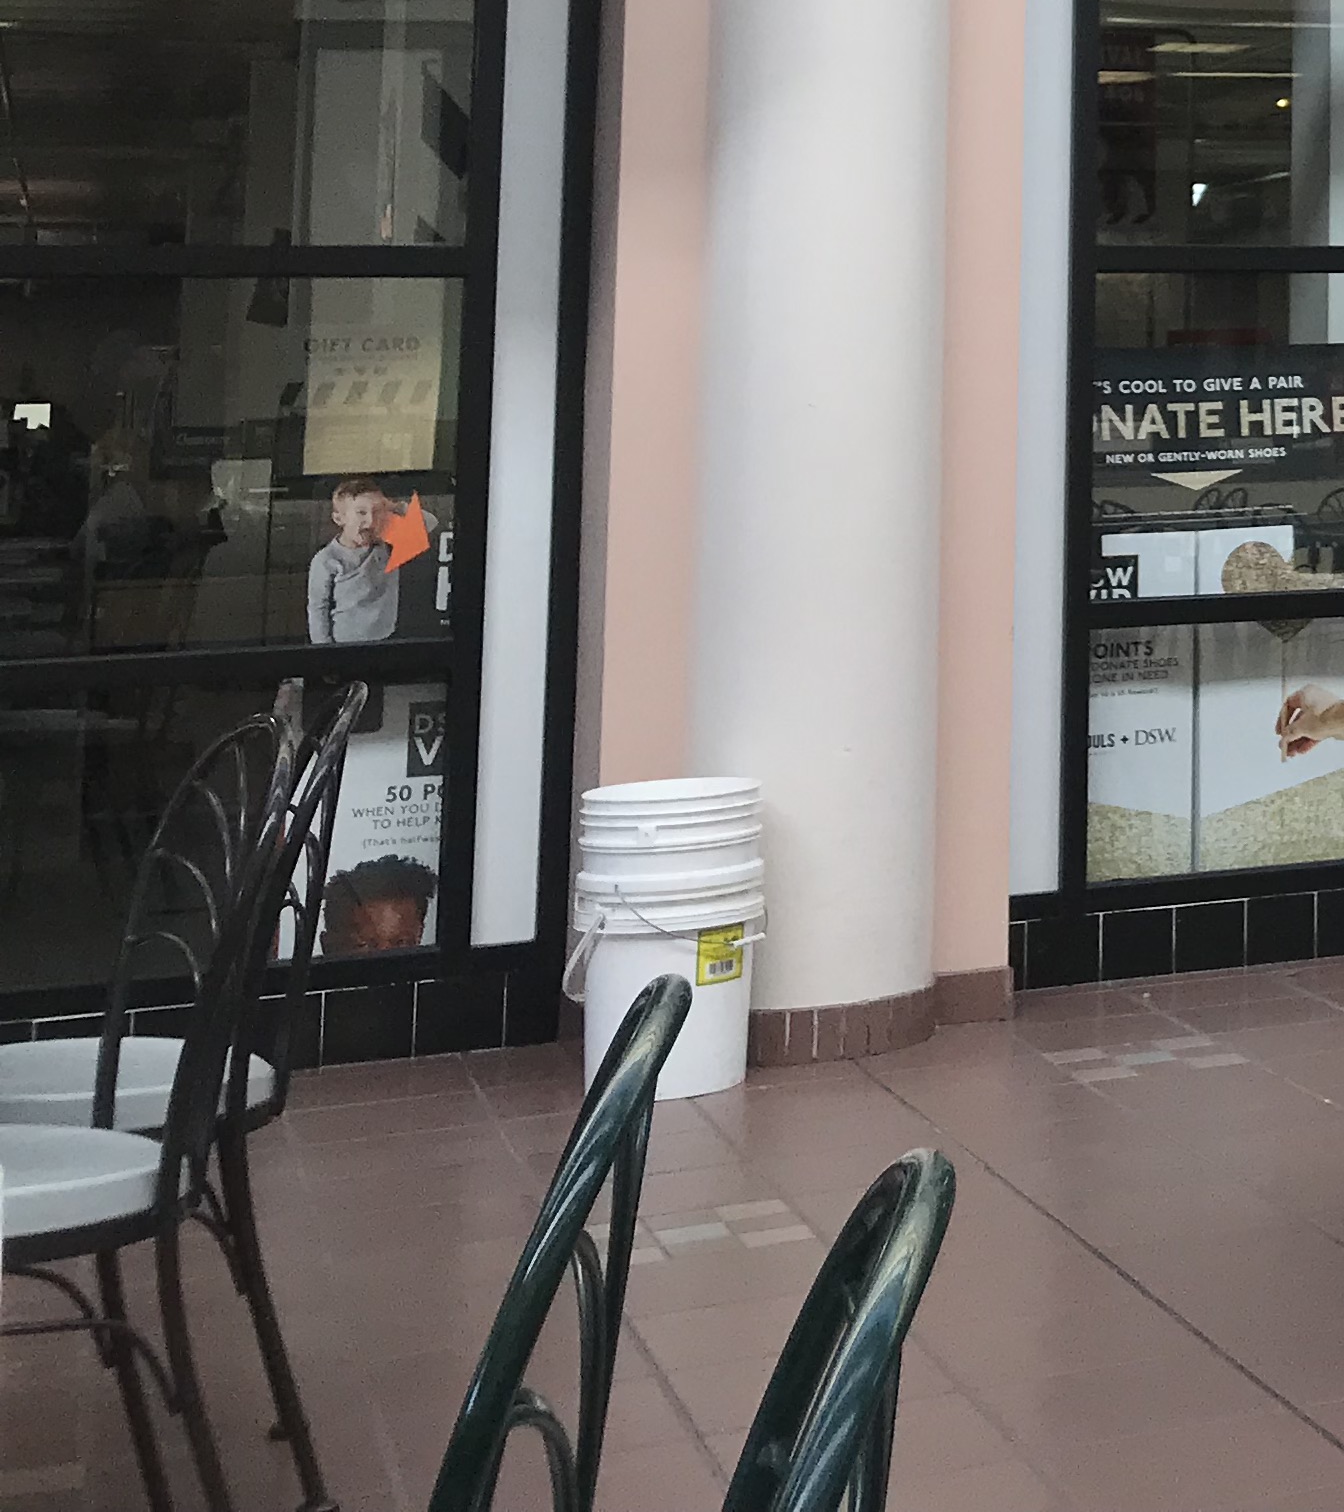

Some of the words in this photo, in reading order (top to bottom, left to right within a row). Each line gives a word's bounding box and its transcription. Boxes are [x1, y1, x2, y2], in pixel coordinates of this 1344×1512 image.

[361, 336, 421, 353] CARD
[1118, 379, 1168, 395] COOL
[1173, 378, 1197, 393] TO
[1202, 377, 1243, 392] GIVE
[1248, 376, 1262, 390] A
[1267, 375, 1304, 390] PAIR
[1092, 401, 1225, 441] NATE
[1105, 452, 1134, 464] NEW
[1137, 451, 1156, 464] OR
[1157, 448, 1244, 464] GENTLY-WORN
[1247, 446, 1287, 460] SHOES
[385, 784, 413, 803] 50
[351, 806, 395, 818] WHEN
[401, 803, 430, 815] YOU
[372, 818, 392, 830] TO
[396, 815, 431, 828] HELP
